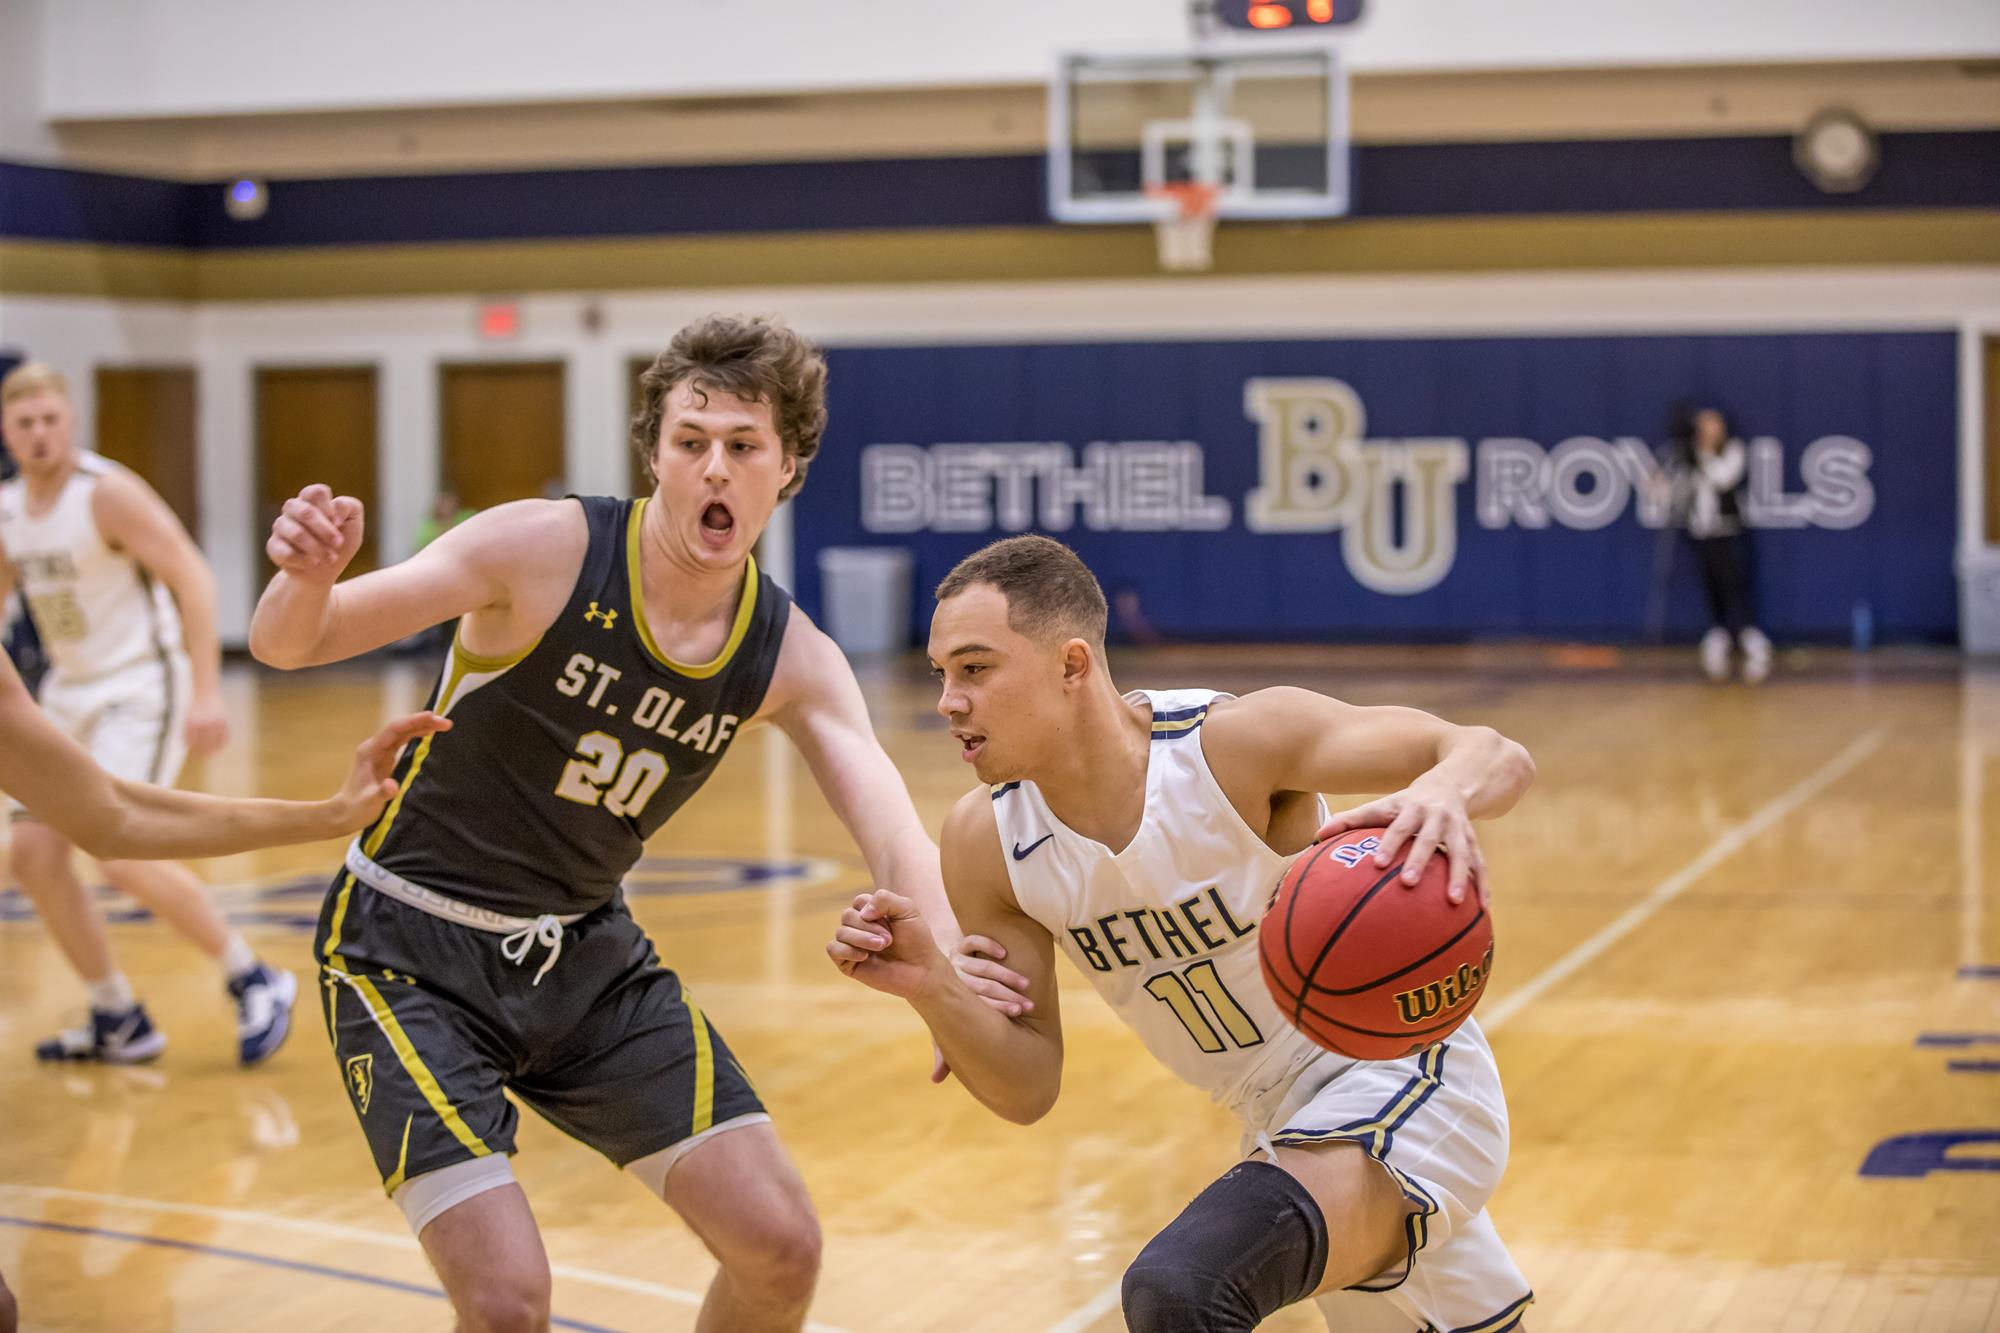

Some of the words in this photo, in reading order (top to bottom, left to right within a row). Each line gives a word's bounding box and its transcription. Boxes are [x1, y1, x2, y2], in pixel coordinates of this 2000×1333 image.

[860, 441, 1232, 534] BETHEL
[1243, 377, 1469, 596] BU
[1475, 435, 1876, 530] ROYLS
[555, 653, 622, 716] ST.
[632, 687, 739, 754] OLAF
[554, 730, 670, 818] 20
[1067, 887, 1257, 972] BETHEL
[1142, 958, 1265, 1053] 11
